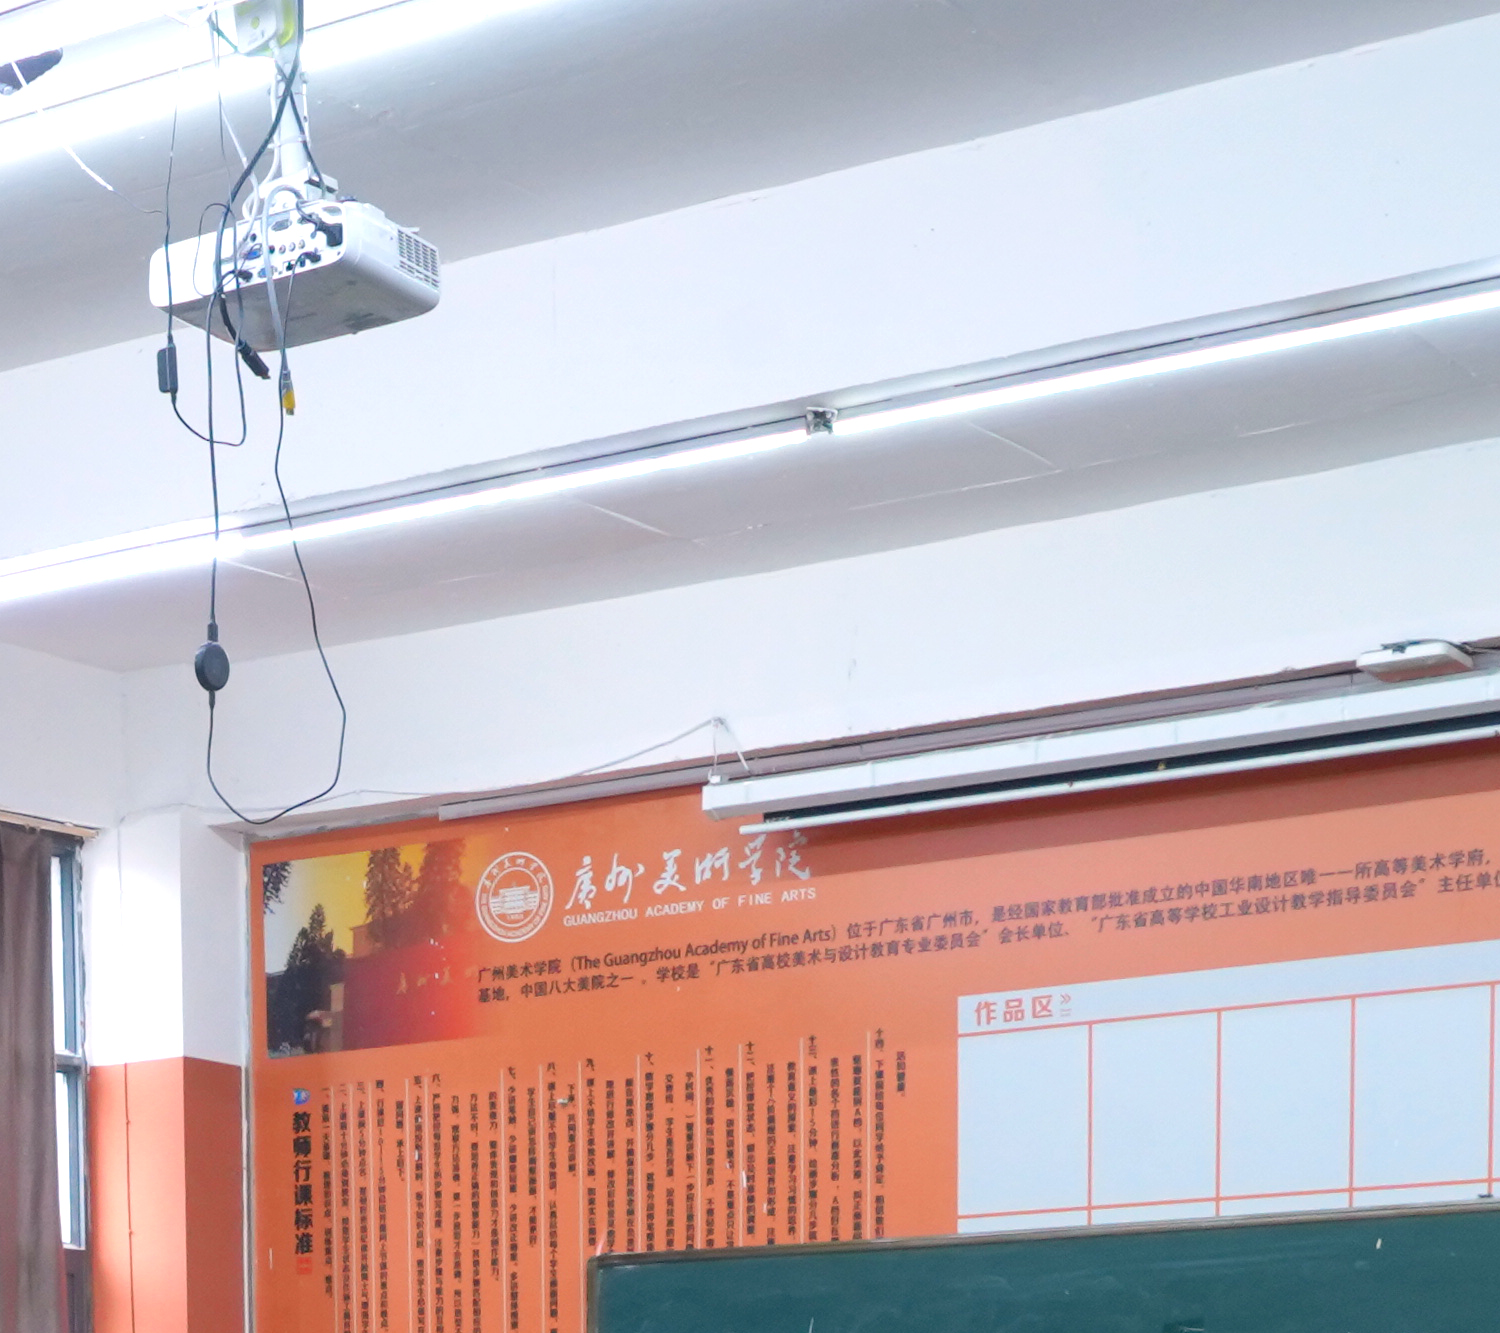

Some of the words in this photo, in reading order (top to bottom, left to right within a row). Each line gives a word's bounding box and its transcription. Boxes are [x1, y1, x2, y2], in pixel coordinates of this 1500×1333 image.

[563, 907, 639, 928] GUANGZHOU
[645, 900, 704, 918] ACADEMY
[712, 898, 731, 910] OF
[738, 893, 772, 907] FINE
[781, 887, 817, 903] ARTS
[604, 944, 682, 968] Guangzhou
[685, 938, 749, 961] Academy
[753, 935, 767, 950] of
[769, 931, 800, 948] Fine
[974, 995, 1055, 1026] 作品区
